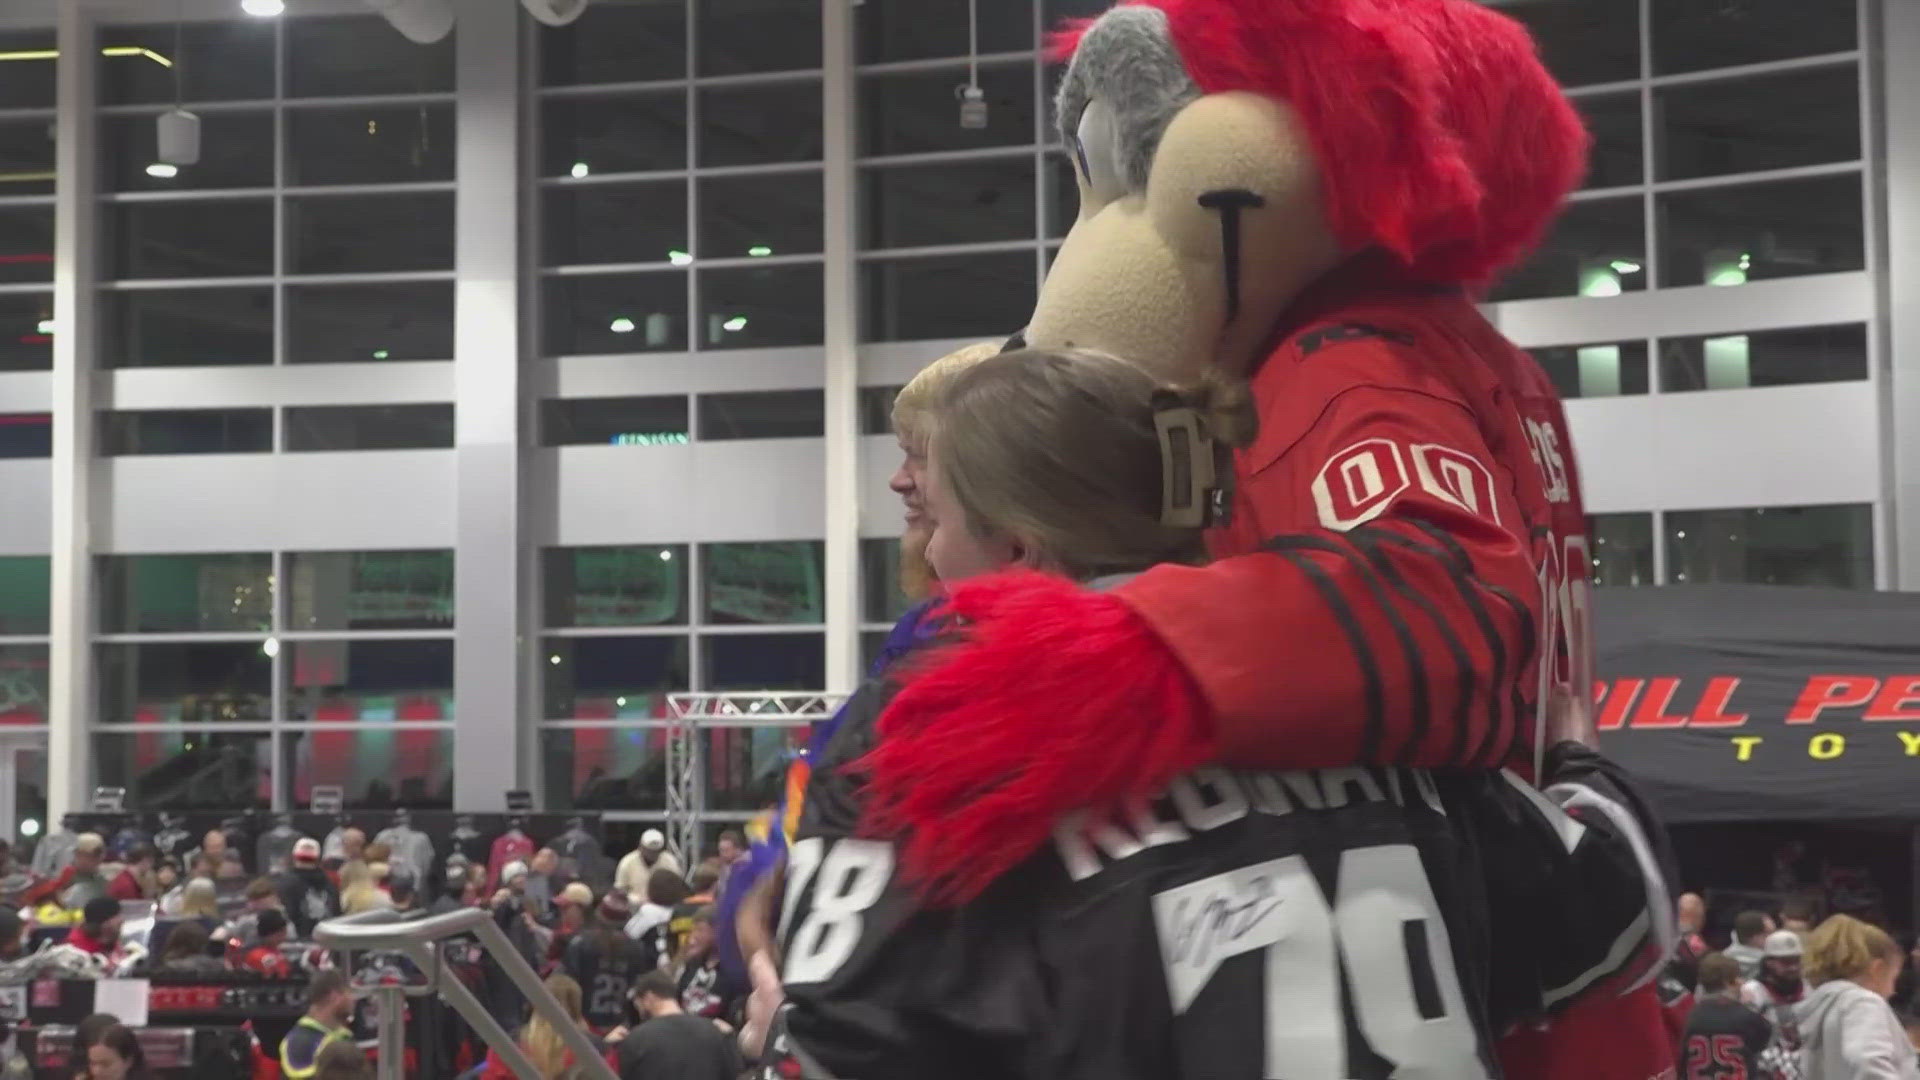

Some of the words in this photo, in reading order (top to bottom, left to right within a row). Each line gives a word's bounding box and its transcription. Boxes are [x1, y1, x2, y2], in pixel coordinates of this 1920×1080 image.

[1311, 438, 1501, 532] 00
[1594, 675, 1748, 731] ILL
[776, 836, 897, 985] 78
[1686, 1034, 1748, 1080] 25
